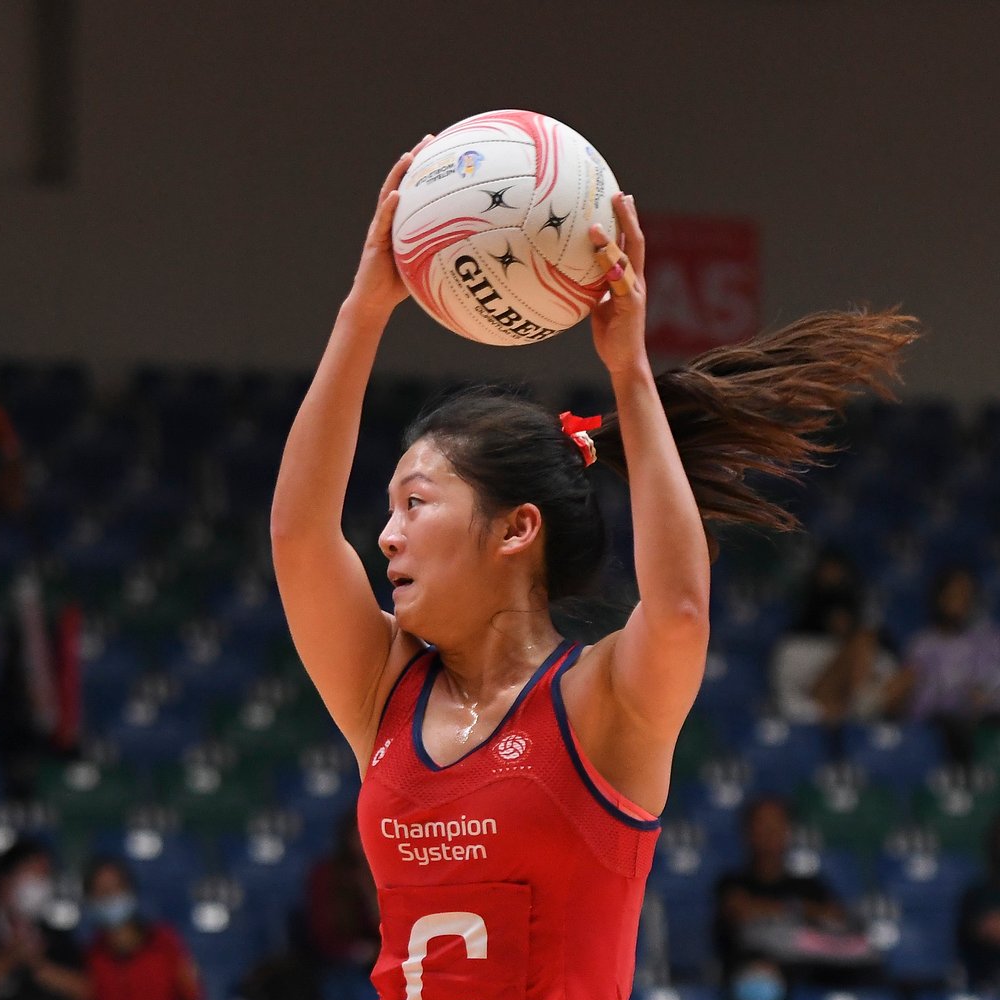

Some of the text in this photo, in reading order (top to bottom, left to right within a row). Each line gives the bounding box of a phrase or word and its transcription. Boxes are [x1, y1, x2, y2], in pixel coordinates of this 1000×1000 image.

[454, 254, 568, 342] GILBER
[380, 815, 498, 842] Champion
[398, 841, 487, 866] System
